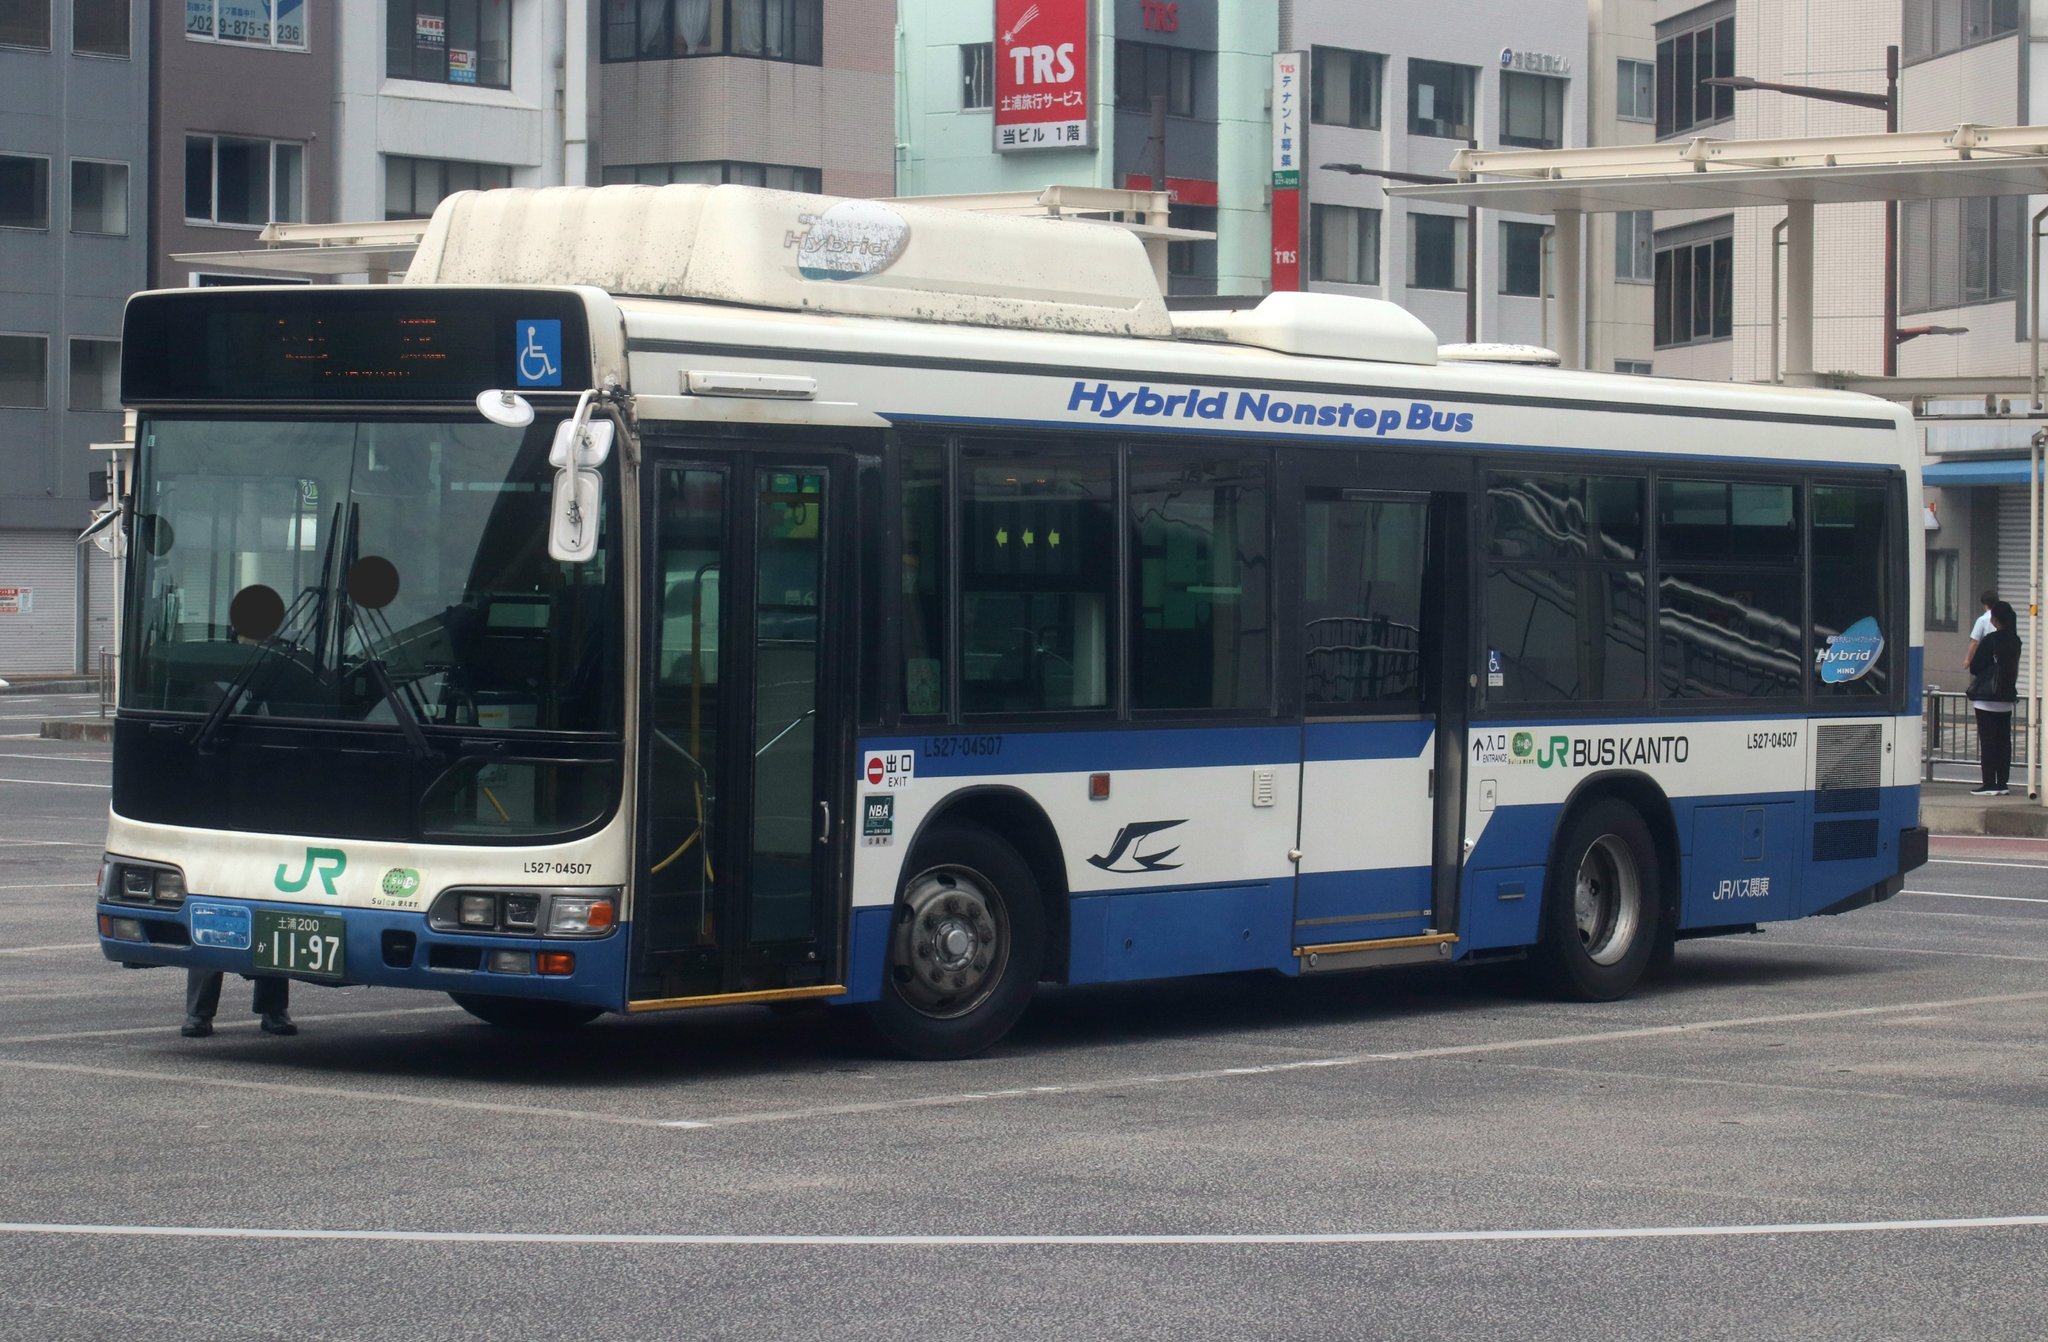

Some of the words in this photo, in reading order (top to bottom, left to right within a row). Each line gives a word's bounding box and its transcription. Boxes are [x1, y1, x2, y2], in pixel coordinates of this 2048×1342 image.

[1141, 1, 1179, 32] TRS
[197, 15, 300, 40] 029-875-5236
[1009, 43, 1075, 85] TRS
[1280, 65, 1295, 73] TRS
[1001, 91, 1083, 112] 土浦旅行サービス
[1281, 76, 1292, 166] テナント募集
[784, 230, 890, 256] Hybrid
[1275, 250, 1296, 264] TRS
[1067, 382, 1228, 420] Hybrid
[1235, 392, 1402, 435] Nonstop
[1406, 403, 1473, 433] Bus
[1816, 648, 1871, 663] Hybrid
[924, 736, 1003, 757] L527-04507
[1486, 735, 1505, 751] 入口
[1747, 732, 1798, 749] L527-04507
[1483, 754, 1507, 763] ENTRANCE
[1537, 736, 1569, 768] JR
[1573, 738, 1615, 767] BUS
[1620, 736, 1689, 765] KANTO
[886, 754, 911, 773] 出口
[889, 777, 907, 787] EXIT
[868, 804, 889, 817] NBA
[274, 847, 347, 895] JR
[524, 862, 592, 875] L527-04507
[1713, 877, 1770, 900] JRバス関東
[273, 931, 340, 971] 11-97
